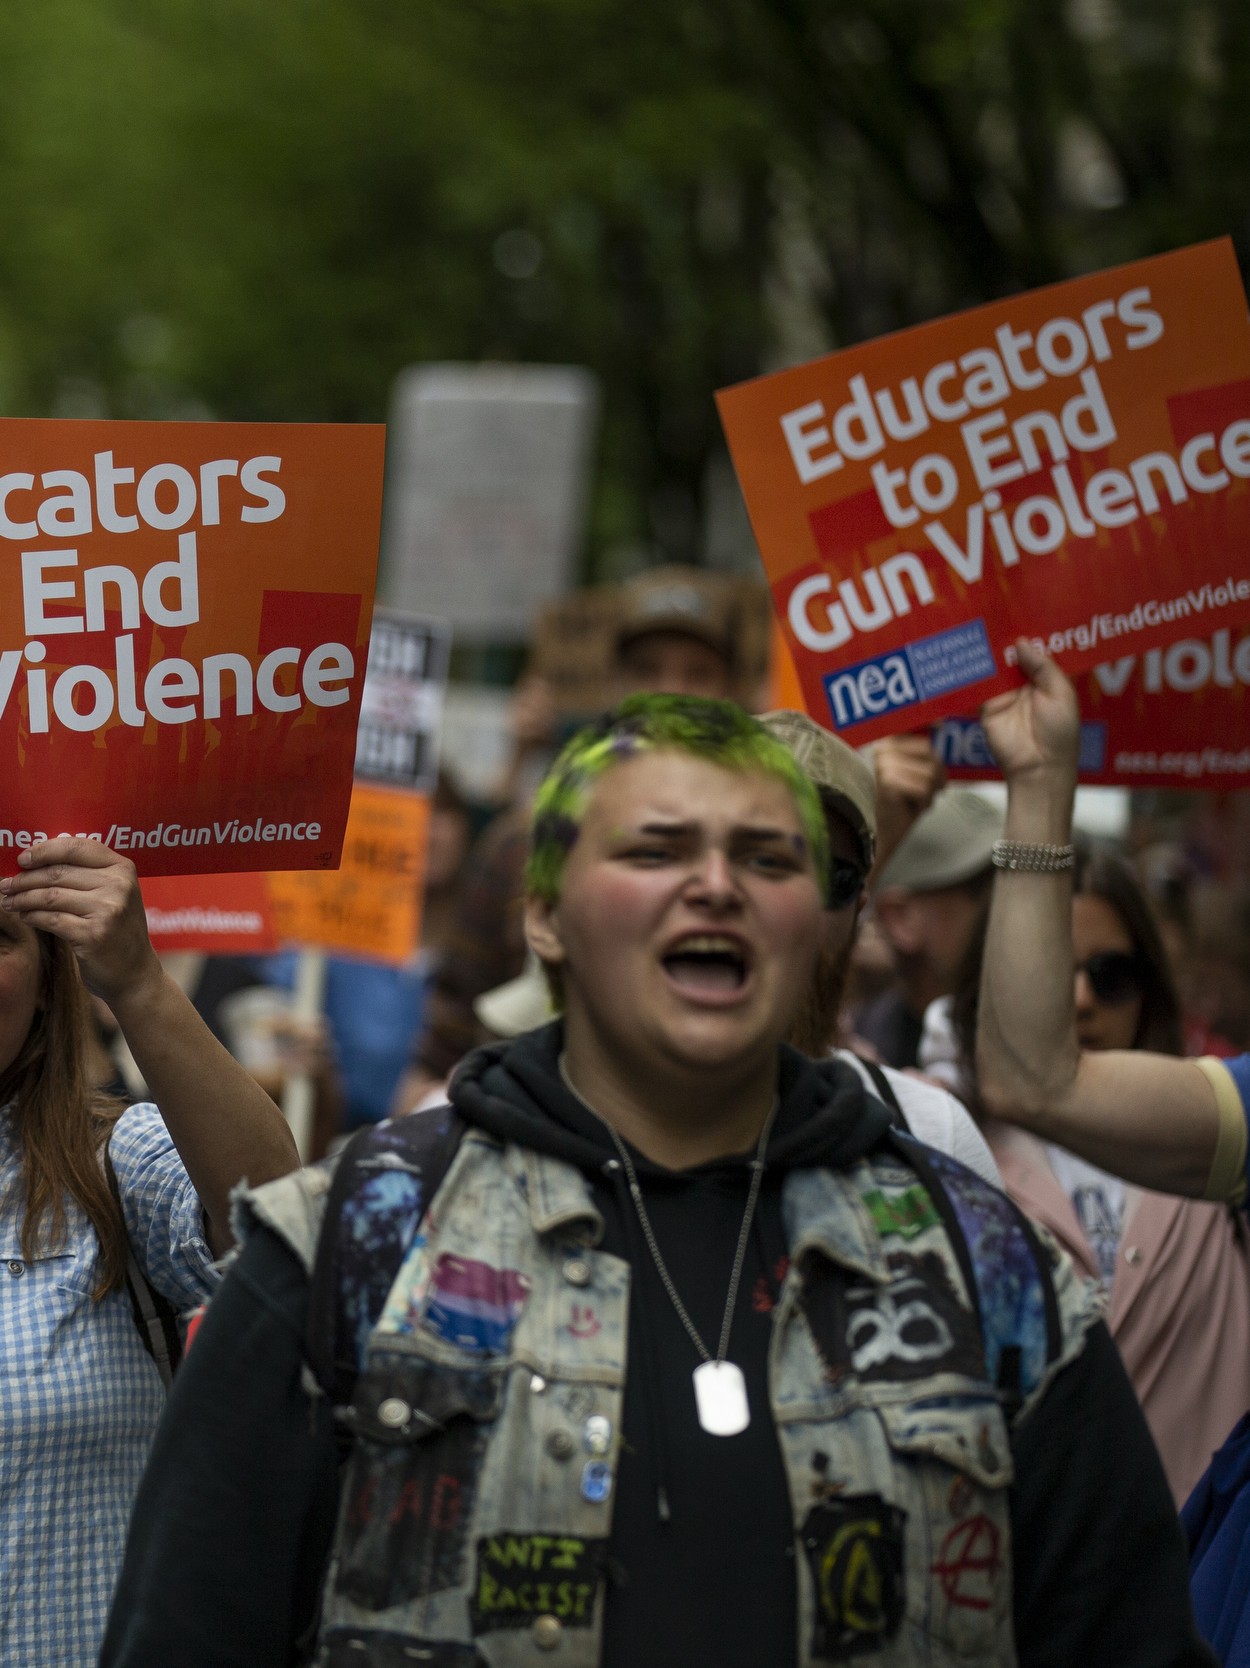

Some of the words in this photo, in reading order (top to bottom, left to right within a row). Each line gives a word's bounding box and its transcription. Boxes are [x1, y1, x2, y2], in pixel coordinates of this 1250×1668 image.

[780, 286, 1164, 485] Educators
[870, 461, 959, 529] to
[960, 366, 1118, 491] End
[20, 531, 200, 637] End
[787, 553, 935, 653] Gun
[924, 420, 1250, 583] Violence
[828, 655, 917, 726] nea
[479, 1570, 592, 1618] RACIST
[485, 1536, 585, 1571] ANTI
